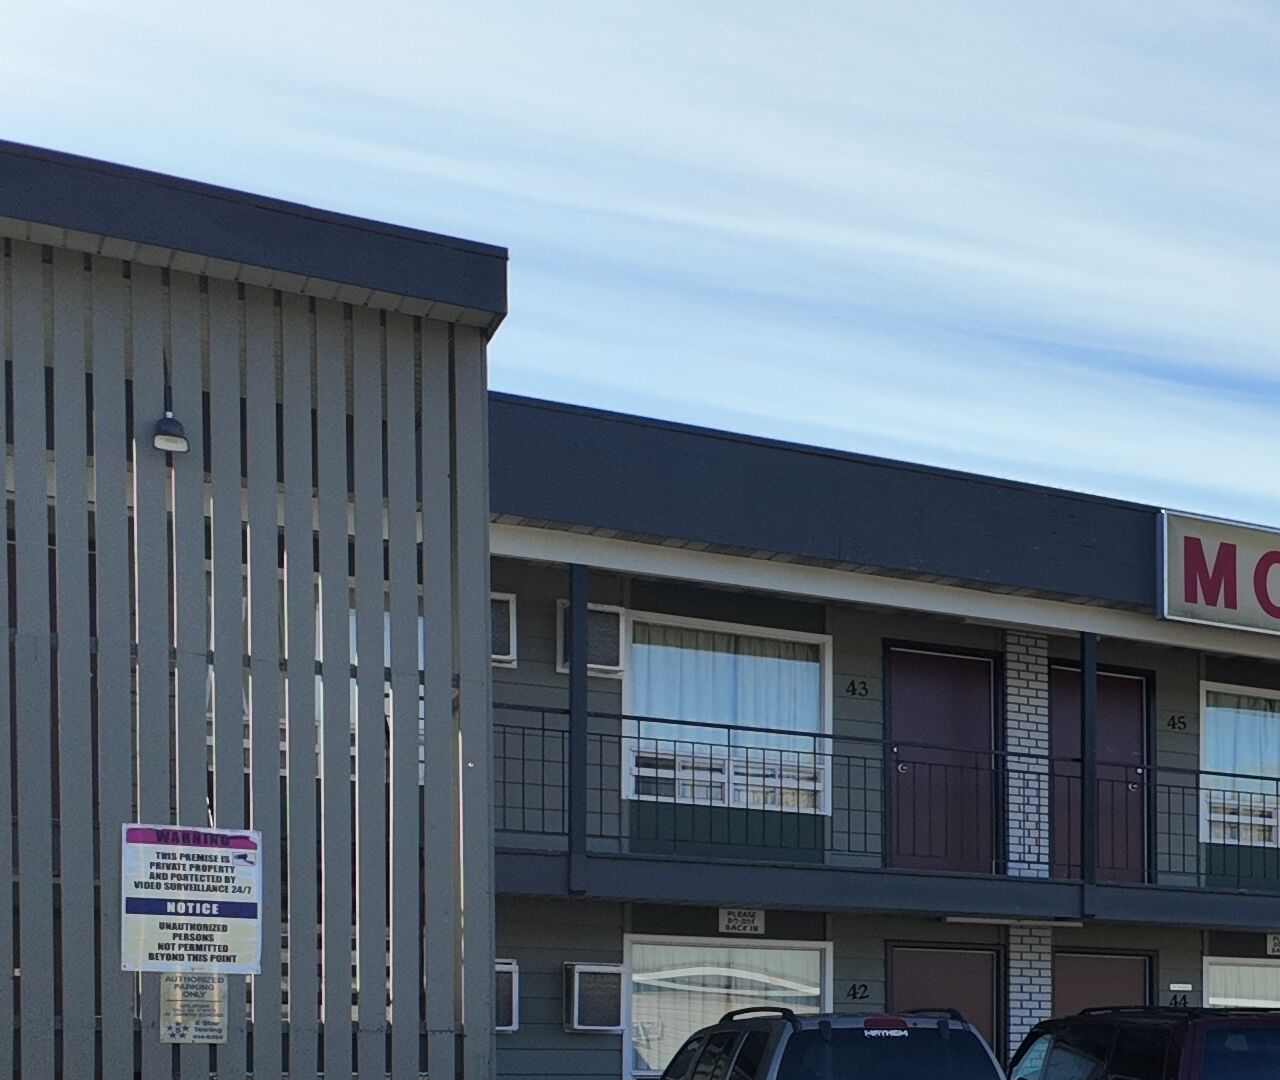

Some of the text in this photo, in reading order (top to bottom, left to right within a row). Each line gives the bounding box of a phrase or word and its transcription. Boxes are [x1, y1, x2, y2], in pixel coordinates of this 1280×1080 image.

[846, 679, 869, 697] 43
[1167, 715, 1187, 730] 45
[155, 829, 230, 846] WARNING
[155, 852, 230, 863] THIS PREMISE IS
[149, 862, 235, 873] PRIVATE PROPERTY
[149, 873, 168, 881] AND
[224, 875, 236, 884] BY
[133, 881, 252, 895] VIDEO SURVEILLANCE 24/7
[166, 902, 220, 915] NOTICE
[727, 910, 757, 918] PLEASE
[158, 922, 228, 932] UNAUTHORIZED
[172, 933, 215, 942] PERSONS
[158, 942, 229, 953] NOT PERMITTED
[148, 952, 237, 963] BEYOND THIS POINT
[846, 983, 870, 1000] 42
[1169, 994, 1189, 1008] 44
